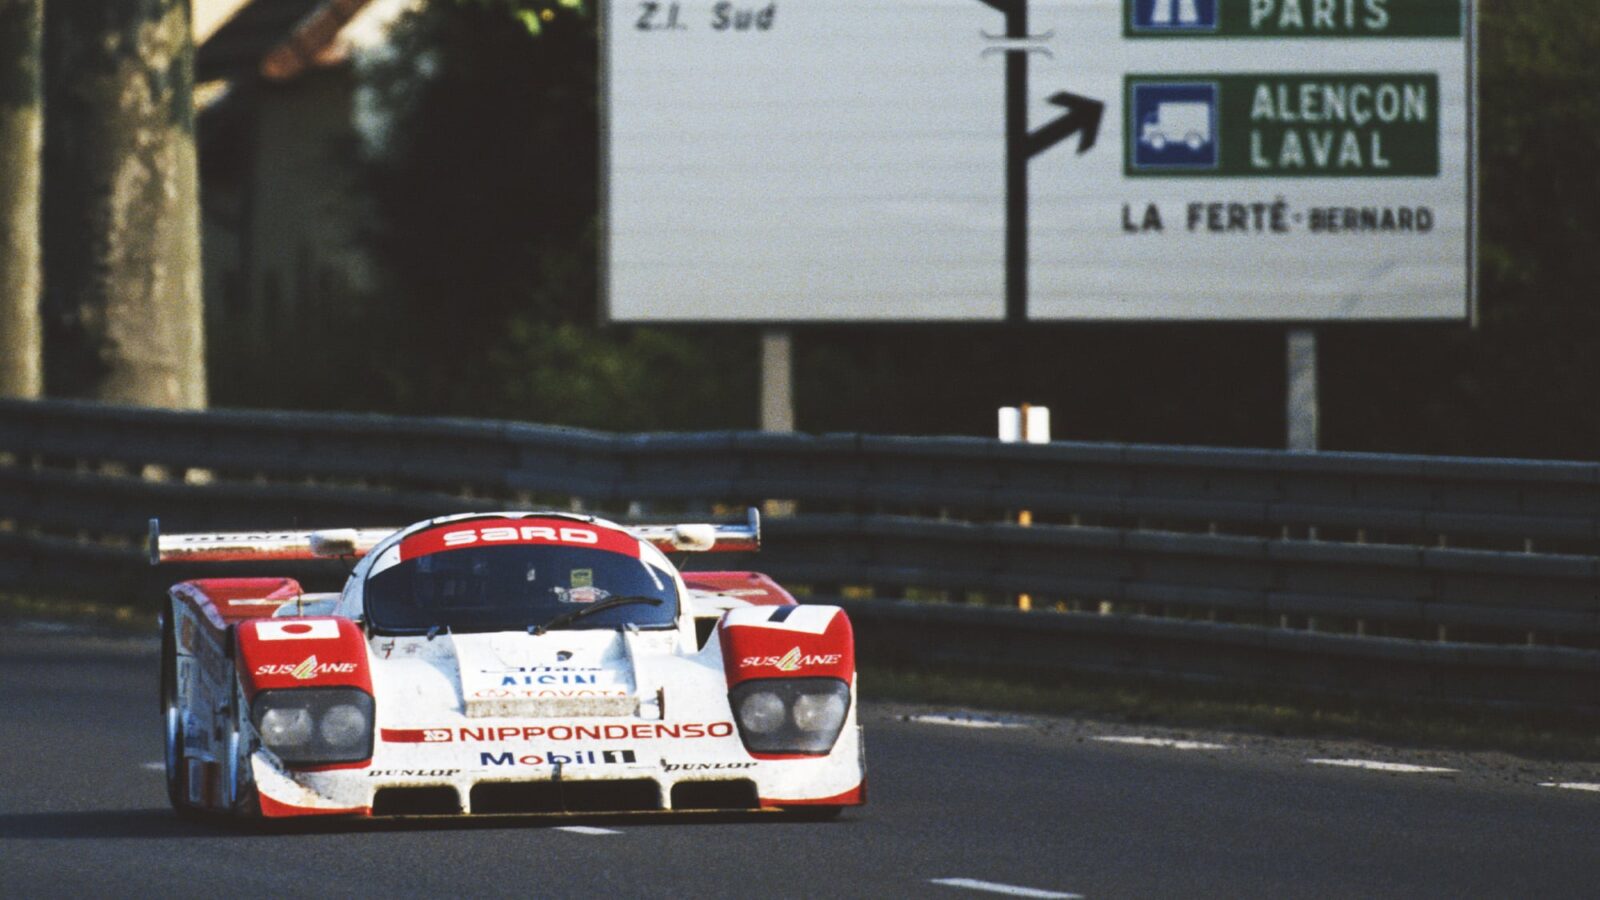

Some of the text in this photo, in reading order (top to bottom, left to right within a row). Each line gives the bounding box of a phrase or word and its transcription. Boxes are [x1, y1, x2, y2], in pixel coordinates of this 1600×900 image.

[711, 1, 777, 31] Sud
[1250, 0, 1390, 29] PARIS
[1251, 83, 1428, 124] ALENÇON
[1251, 129, 1390, 168] LAVAL
[1122, 203, 1163, 232] LA
[459, 722, 733, 742] NIPPONDENSO
[368, 769, 461, 778] DUNLOP
[664, 762, 758, 773] DUNLOP
